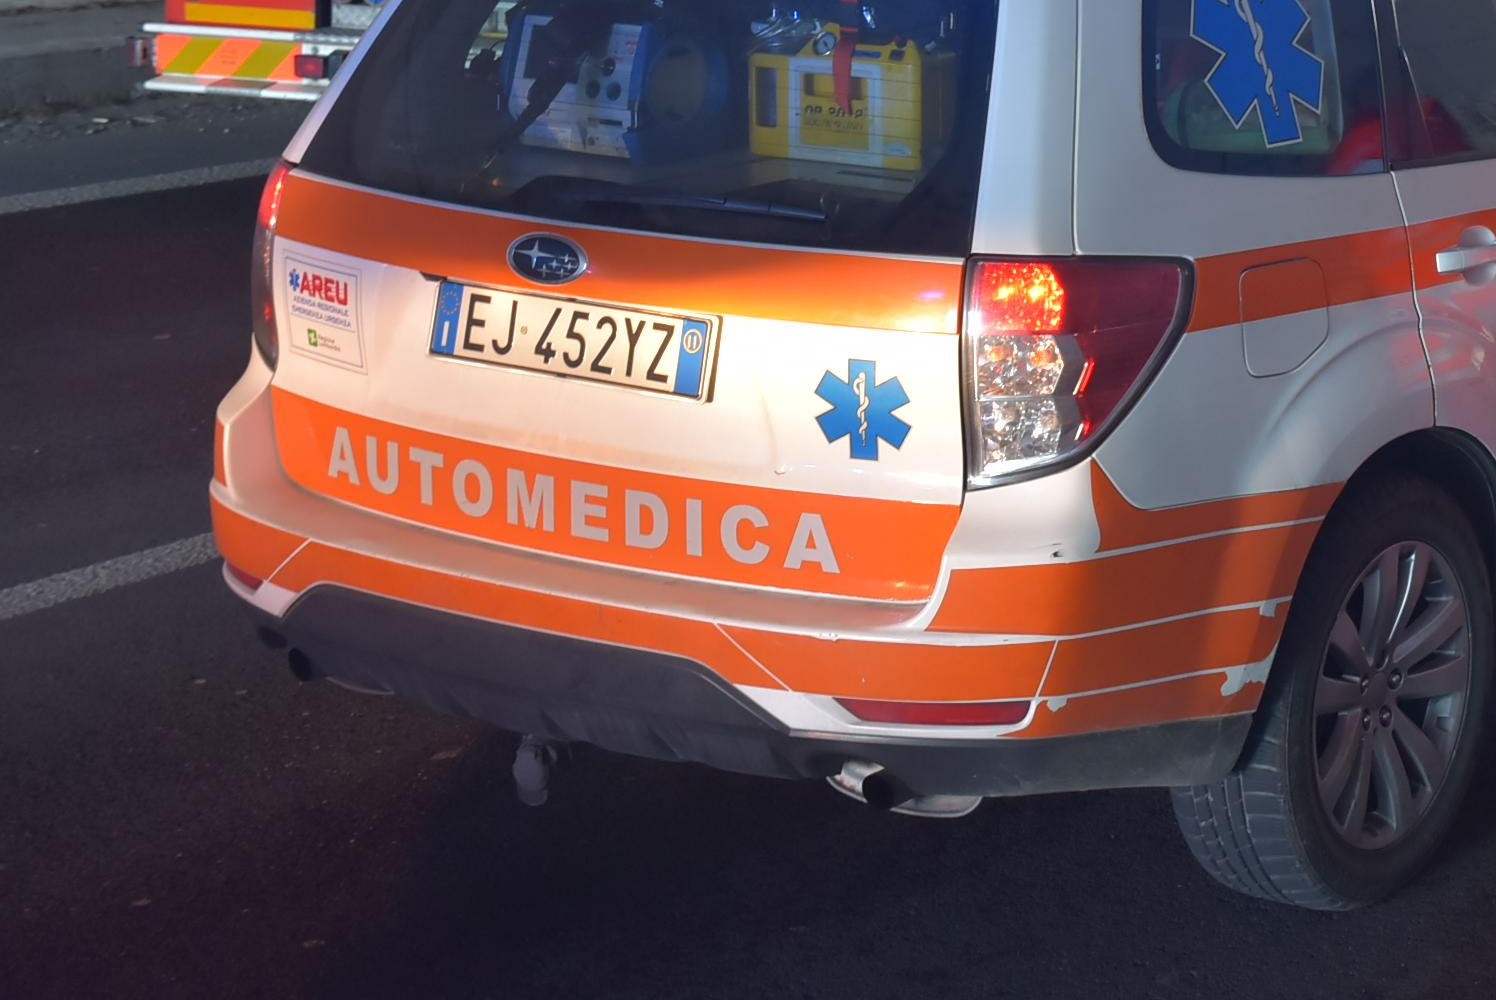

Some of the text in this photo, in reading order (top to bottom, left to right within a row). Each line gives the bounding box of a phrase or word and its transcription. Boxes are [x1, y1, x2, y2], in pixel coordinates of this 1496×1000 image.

[300, 270, 349, 307] AREU
[462, 293, 518, 356] EJ
[533, 307, 676, 384] 452YZ
[327, 426, 841, 575] AUTOMEDICA
